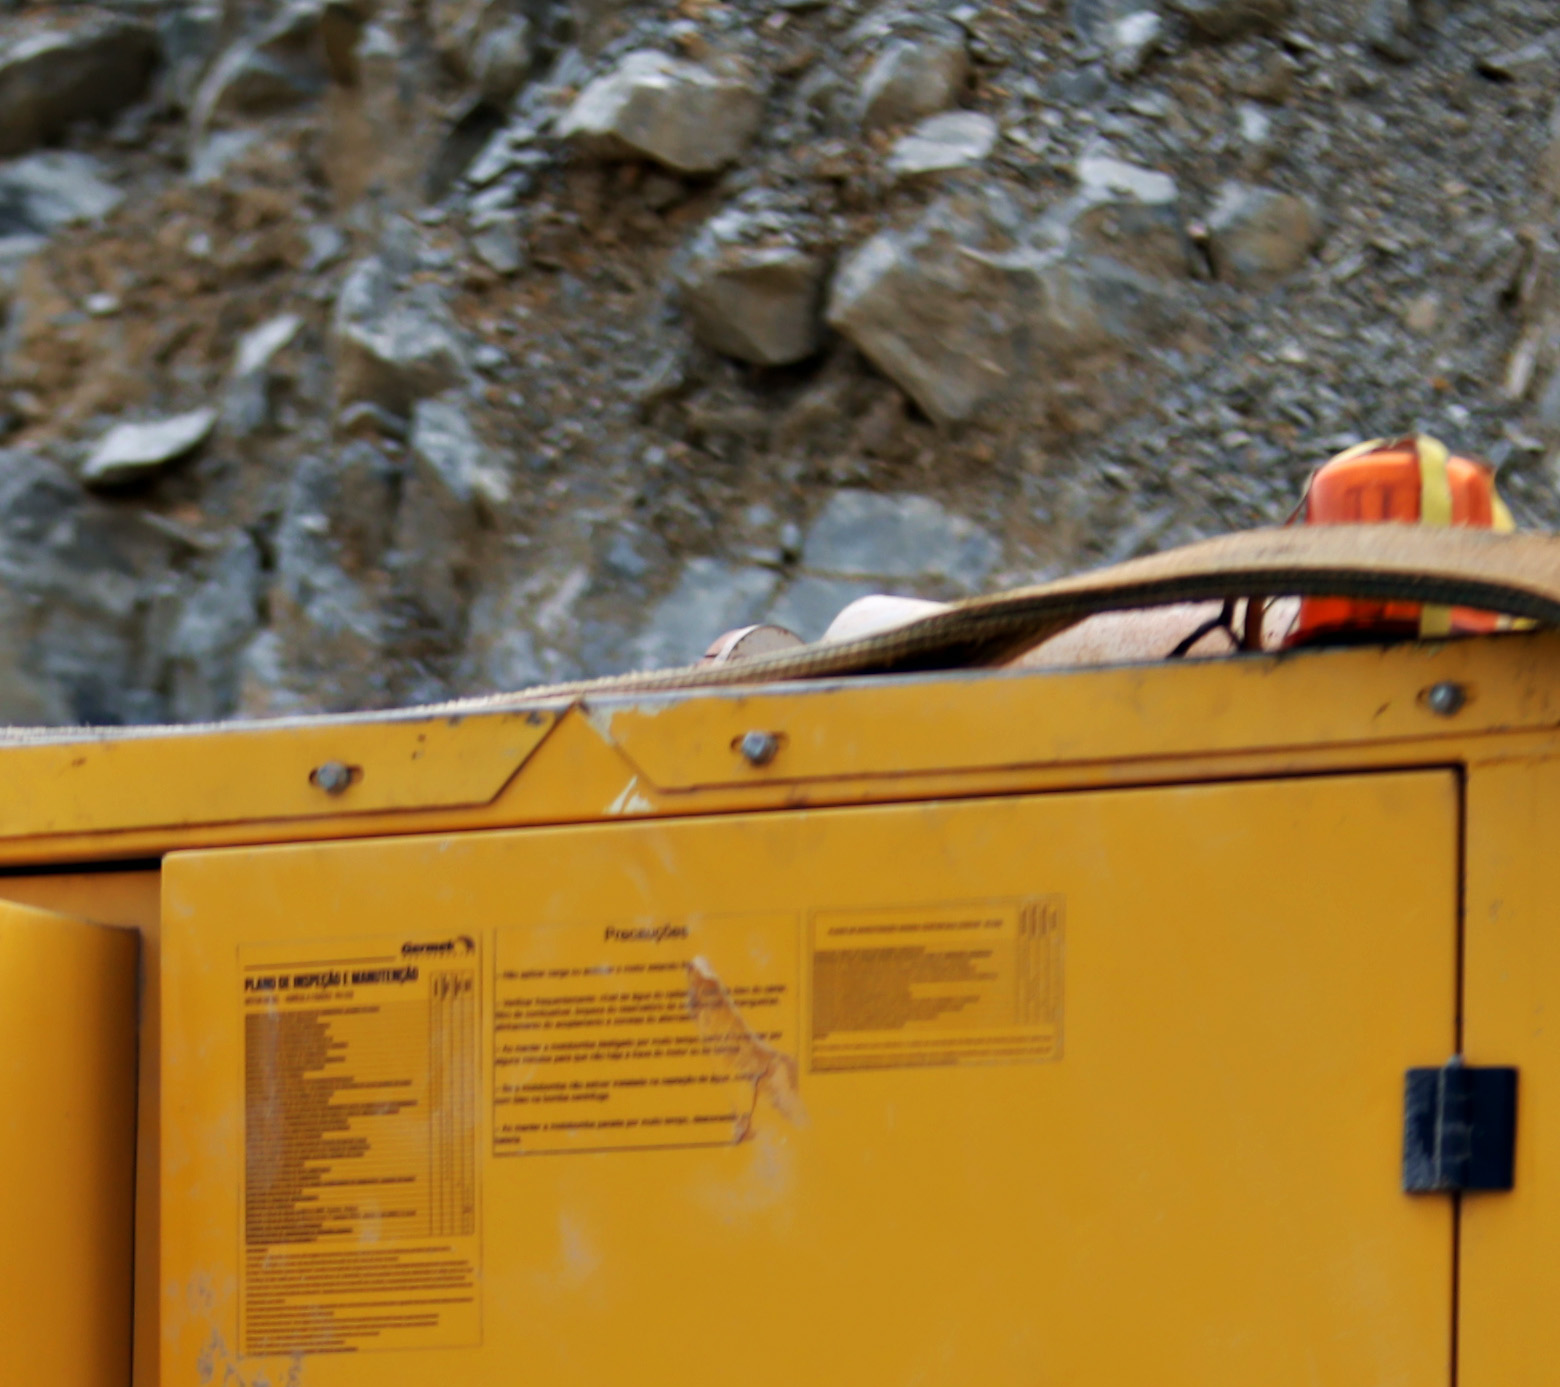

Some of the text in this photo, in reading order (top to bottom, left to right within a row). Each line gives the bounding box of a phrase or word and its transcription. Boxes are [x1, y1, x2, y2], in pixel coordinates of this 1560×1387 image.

[604, 923, 688, 943] Precauções
[245, 976, 276, 991] PLANO
[278, 974, 289, 989] DE
[293, 969, 341, 989] INSPEÇÃO
[351, 966, 419, 986] MANUTENÇÃO
